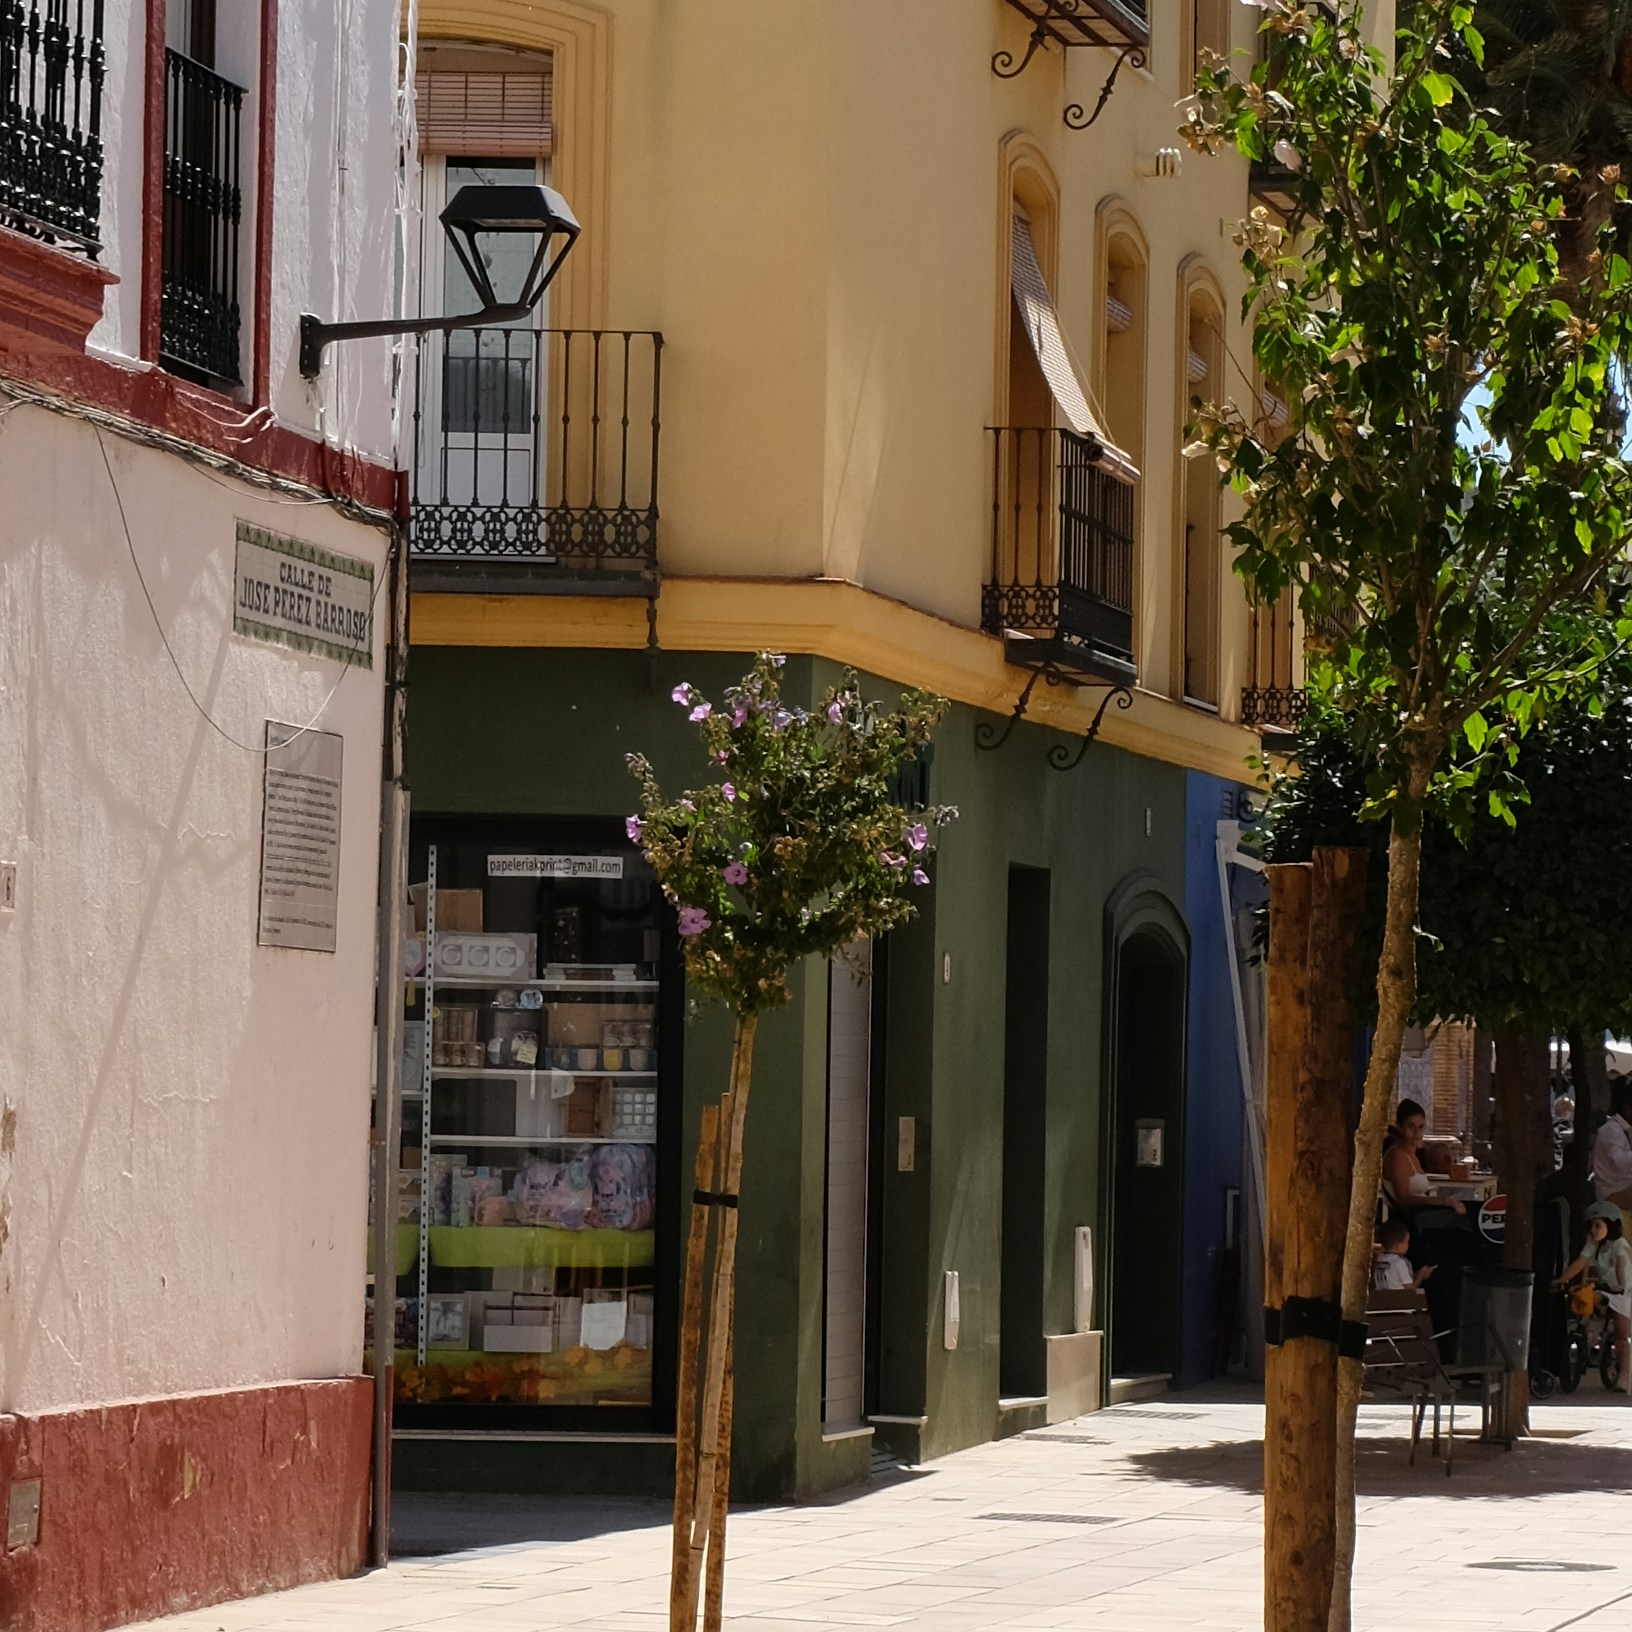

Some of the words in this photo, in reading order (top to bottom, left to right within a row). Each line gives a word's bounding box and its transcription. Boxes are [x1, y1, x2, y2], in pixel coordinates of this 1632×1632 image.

[279, 561, 315, 593] CALLE
[317, 573, 333, 597] DE
[239, 576, 271, 615] JOSE
[273, 585, 313, 627] PEREZ
[315, 597, 366, 642] BARROSO
